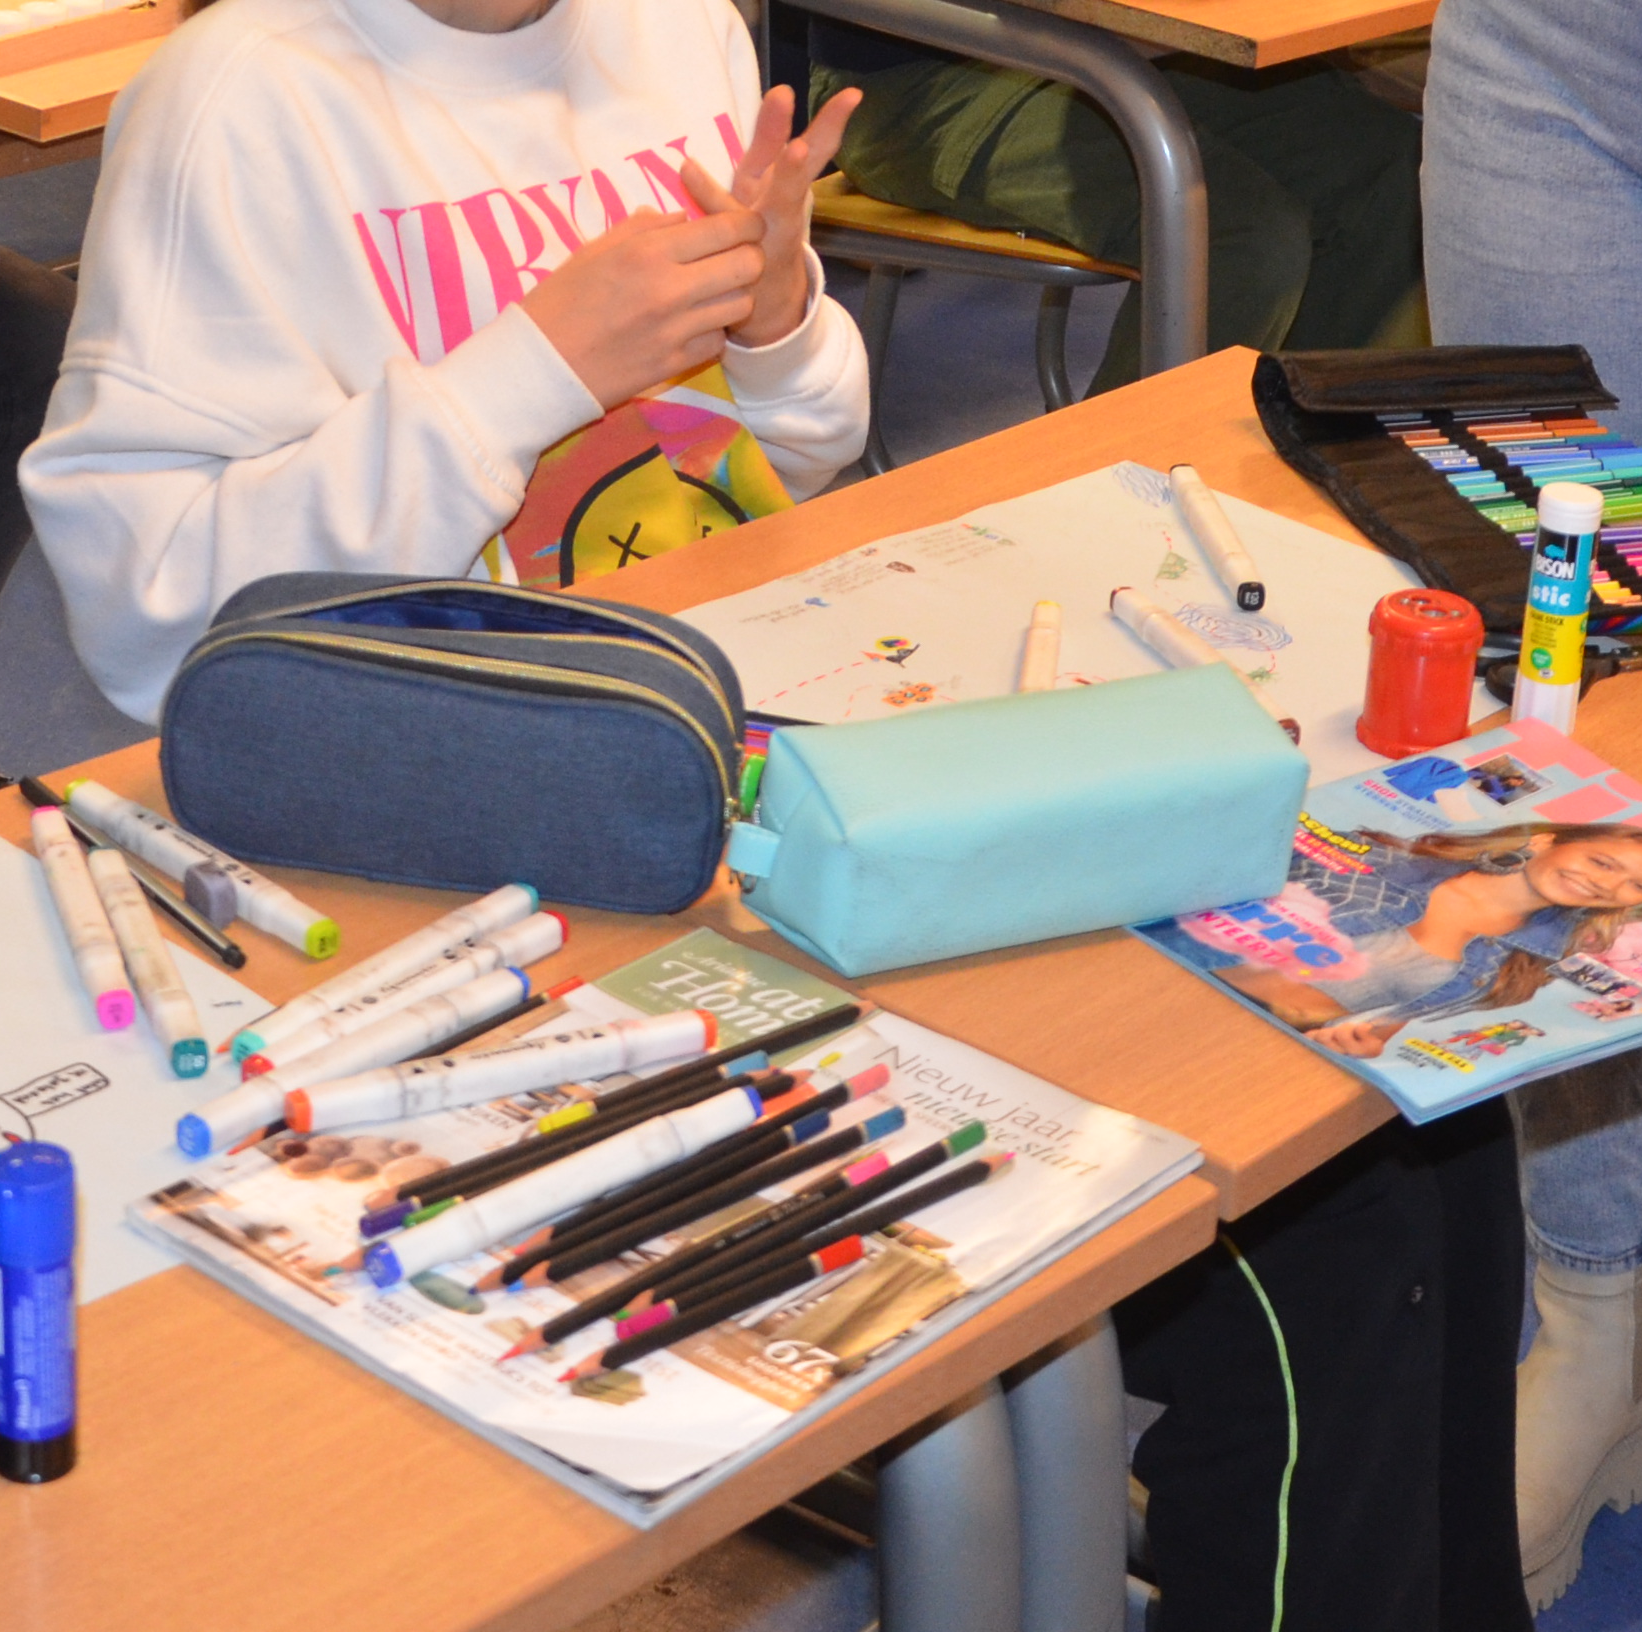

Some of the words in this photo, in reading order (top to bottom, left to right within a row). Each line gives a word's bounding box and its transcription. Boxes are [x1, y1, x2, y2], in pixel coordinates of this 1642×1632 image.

[1532, 584, 1571, 607] stic
[1363, 779, 1398, 799] SHOP
[648, 960, 787, 1035] Hom
[750, 988, 825, 1020] at
[872, 1044, 1001, 1109] Nieuw
[1016, 1138, 1101, 1177] start
[764, 1339, 840, 1373] 67
